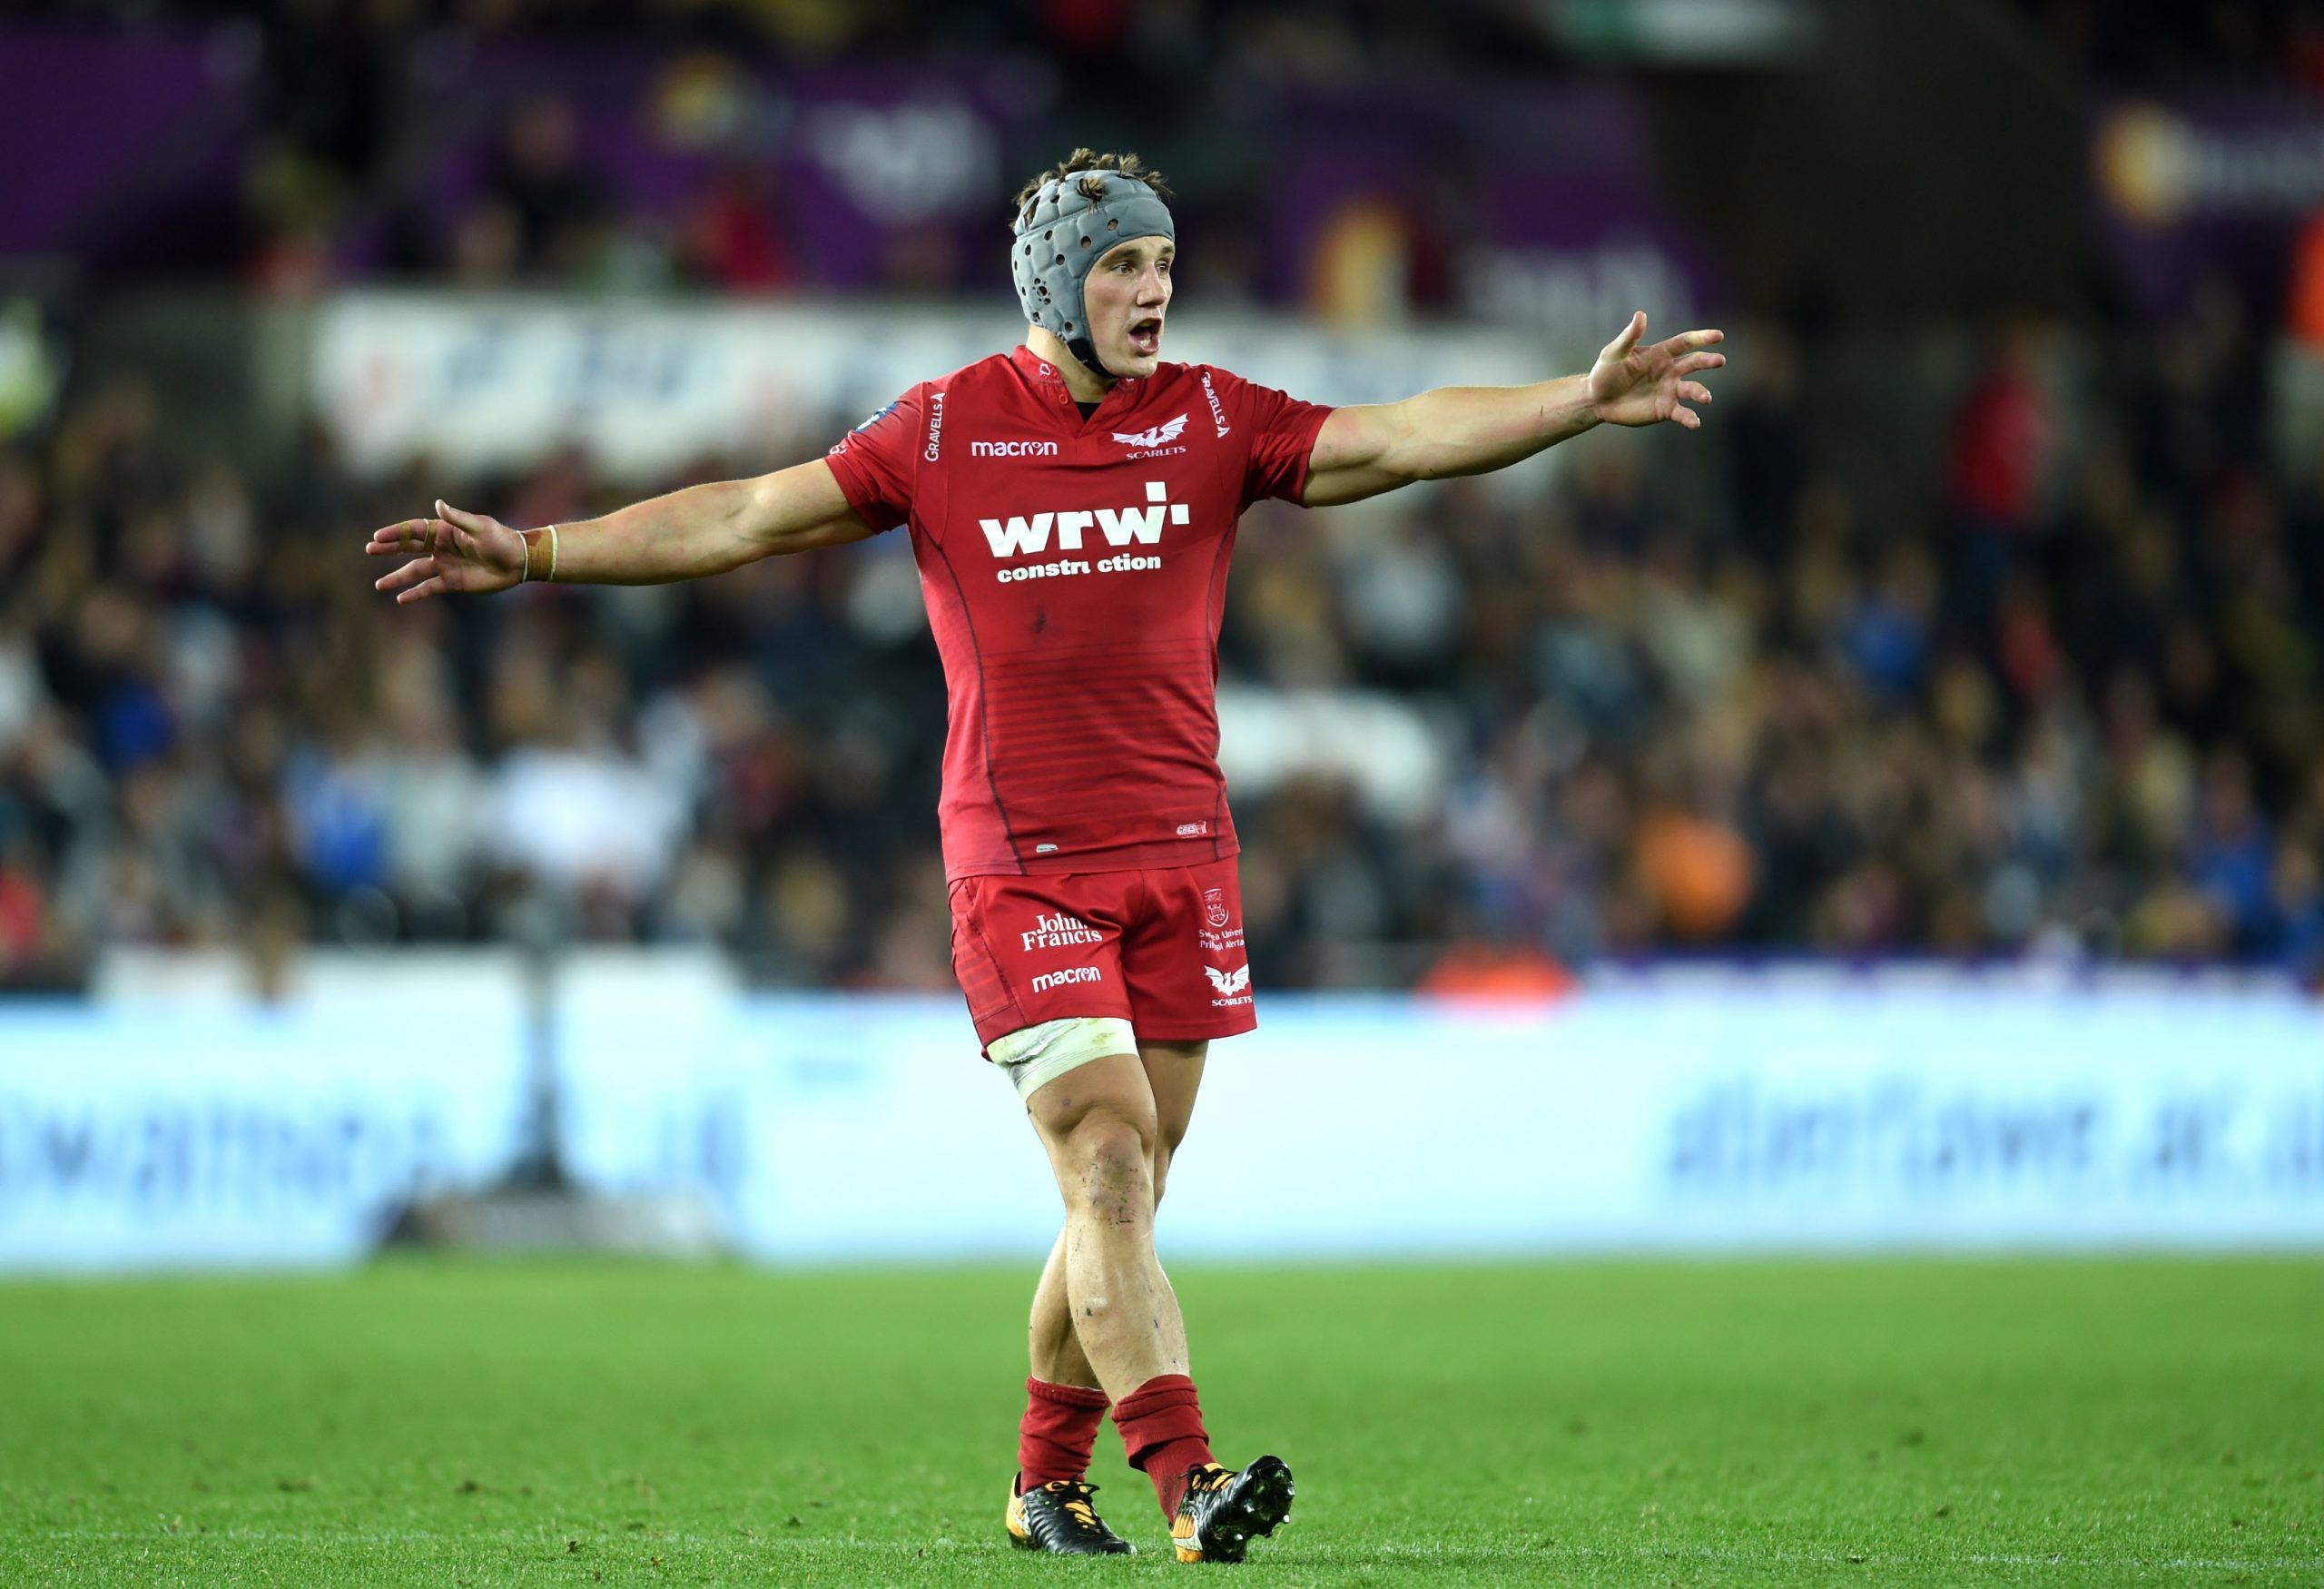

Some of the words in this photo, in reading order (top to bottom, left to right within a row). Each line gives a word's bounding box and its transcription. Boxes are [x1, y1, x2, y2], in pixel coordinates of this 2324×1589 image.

[924, 403, 943, 462] GRAVELLS
[971, 440, 1058, 457] macron
[1126, 446, 1187, 460] SCARLETS
[1036, 913, 1084, 934] John
[1020, 928, 1103, 952] Francis
[1031, 966, 1101, 993] macron
[1211, 996, 1253, 1007] SCARLETS
